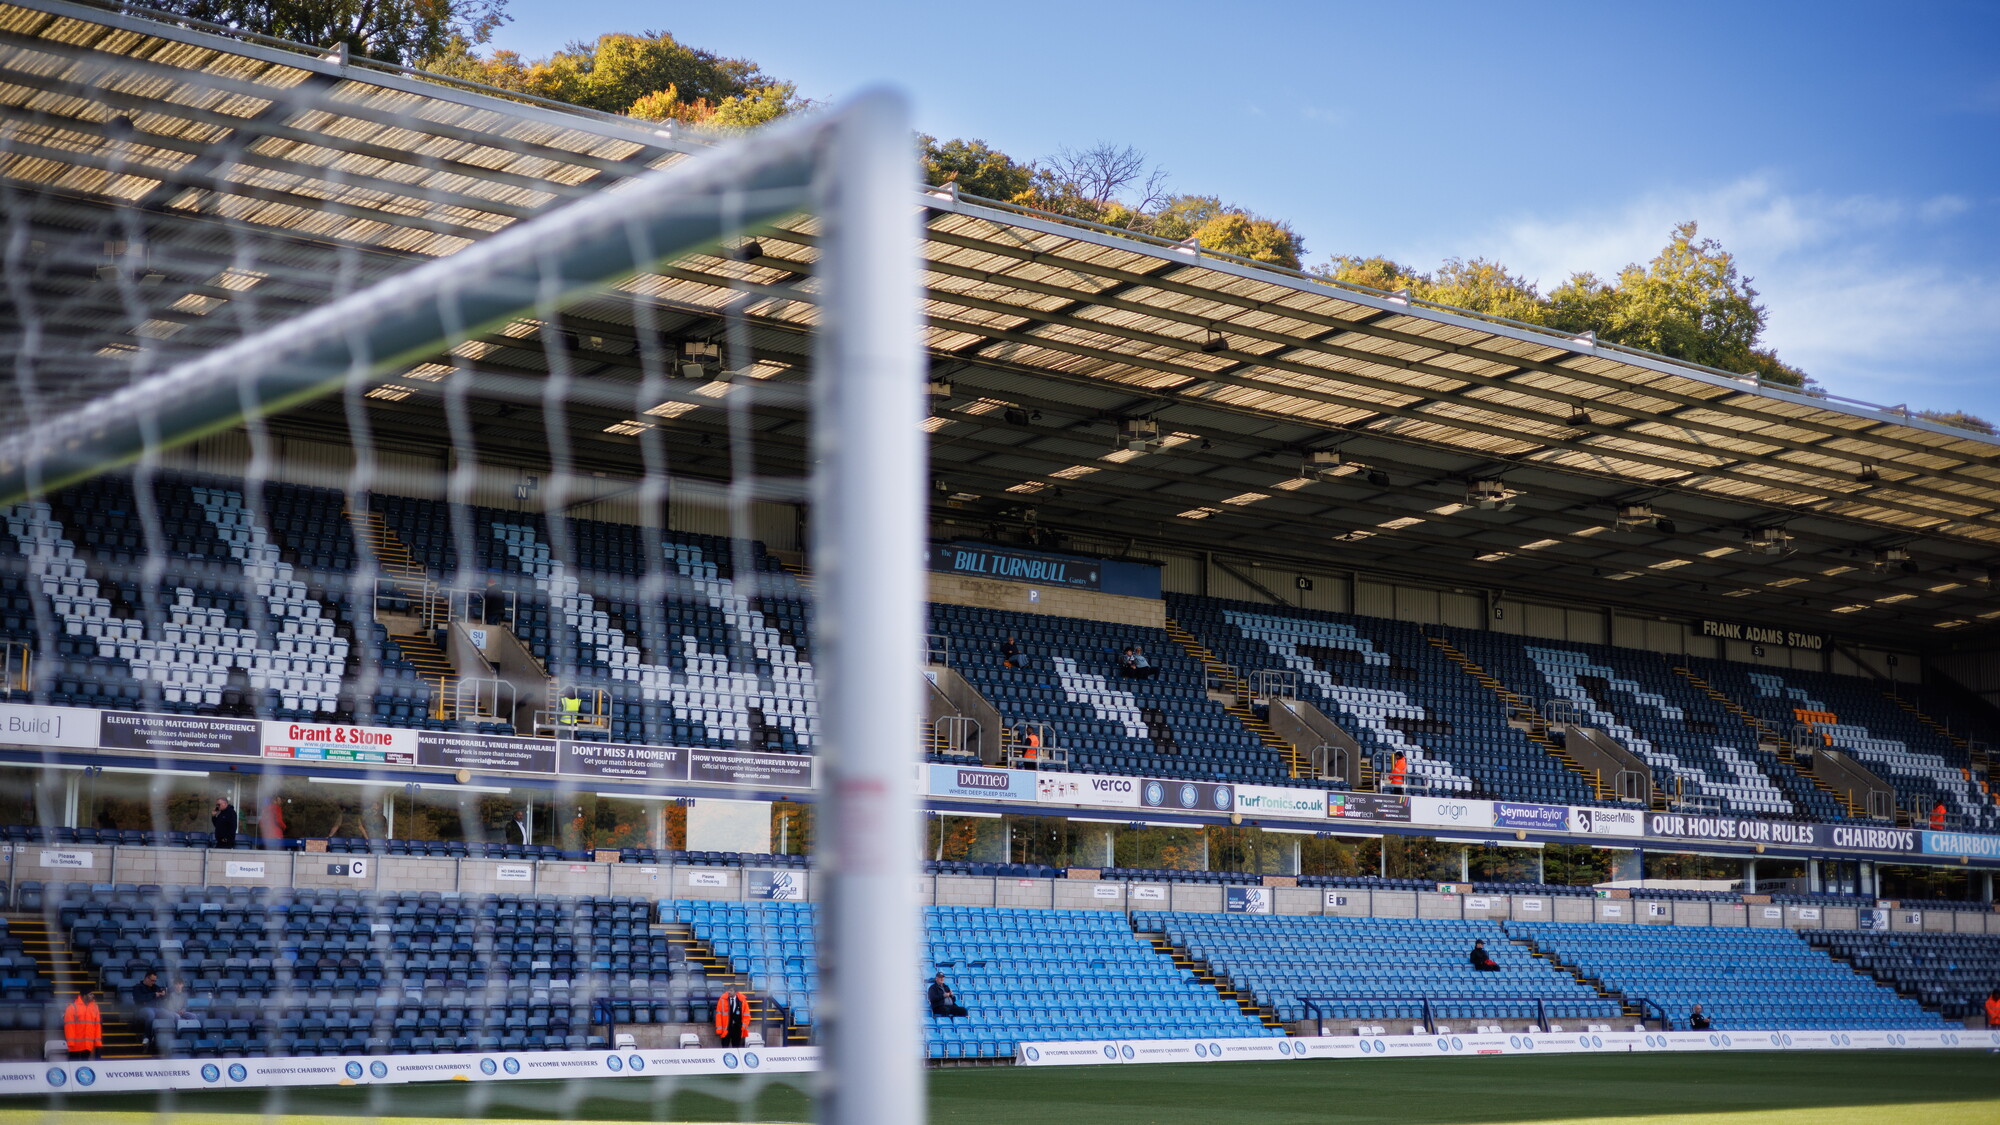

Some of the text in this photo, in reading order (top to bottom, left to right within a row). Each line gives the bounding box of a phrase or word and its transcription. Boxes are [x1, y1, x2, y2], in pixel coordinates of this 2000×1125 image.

[518, 486, 526, 498] N
[954, 551, 987, 573] BILL
[991, 555, 1067, 583] TURNBULL
[1068, 576, 1088, 586] Gantry
[1030, 590, 1038, 601] P
[1496, 609, 1502, 618] R
[472, 631, 484, 640] SU
[1704, 620, 1822, 650] FRANK ADAMS STAND
[1754, 646, 1760, 655] S
[9, 716, 50, 734] Build
[106, 716, 256, 732] ELEVATE YOUR MATCHDAY EXPERIENCE
[134, 728, 232, 741] Private Boxes Available for Hire
[289, 724, 392, 746] Grant & Stone
[146, 738, 220, 749] commercial@wwfc.com
[418, 736, 438, 744] MAKE
[446, 738, 488, 748] MEMORABLE,
[524, 744, 556, 752] AVAILABLE
[504, 752, 532, 760] matchdays
[572, 746, 678, 761] DON'T MISS A MOMENT
[692, 754, 710, 762] SHOW
[455, 757, 520, 766] commercial@wwfc.com
[627, 760, 646, 768] tickets
[602, 767, 647, 776] tickets.wwfc.com
[720, 764, 744, 772] Wycombe
[676, 797, 686, 807] 10
[687, 798, 696, 808] 11
[1238, 794, 1324, 811] TurfTonics.co.uk
[1344, 795, 1366, 804] Thames
[1344, 802, 1352, 810] air
[1438, 802, 1468, 820] origin
[1344, 810, 1374, 818] watertech
[1594, 822, 1610, 834] Law
[1653, 816, 1814, 844] OUR HOUSE OUR RULES
[1833, 828, 1914, 850] CHAIRBOYS
[335, 866, 341, 874] S
[353, 862, 363, 874] C
[1329, 894, 1334, 904] E
[1651, 905, 1656, 913] F
[1914, 914, 1919, 922] G
[145, 1070, 190, 1078] WANDERERS
